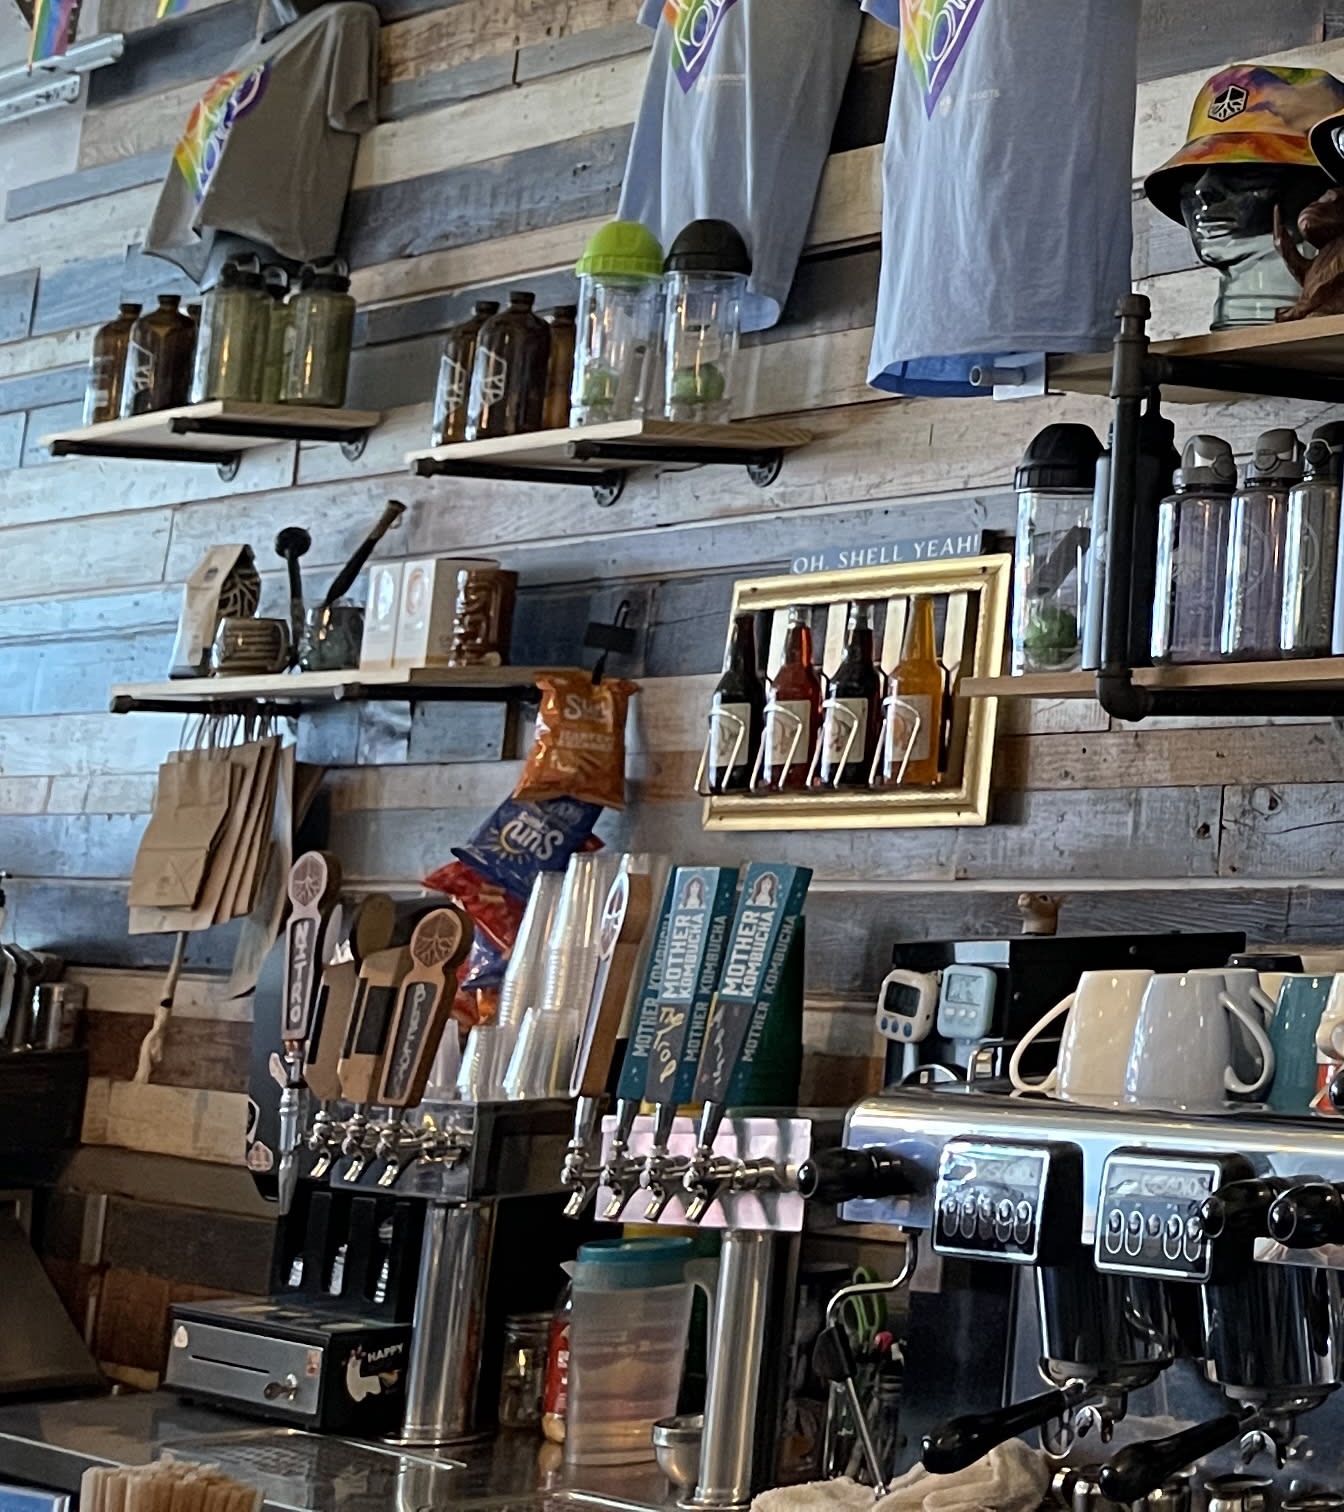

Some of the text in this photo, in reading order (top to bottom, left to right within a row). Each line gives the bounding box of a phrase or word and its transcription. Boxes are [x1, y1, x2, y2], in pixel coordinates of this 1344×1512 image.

[838, 544, 904, 569] SHELL
[913, 534, 979, 559] YEAH!
[662, 914, 691, 999] MOTHER
[678, 912, 705, 999] KOMBUCHA
[684, 1001, 710, 1062] MOTHER
[699, 915, 728, 995] KOMBUCHA
[721, 911, 761, 996] MOTHER
[740, 910, 775, 997] KOMBUCHA
[742, 915, 798, 1062] MOTHER KOMBUCHA
[632, 997, 658, 1057] MOTHER
[368, 1342, 404, 1363] HAPPY
